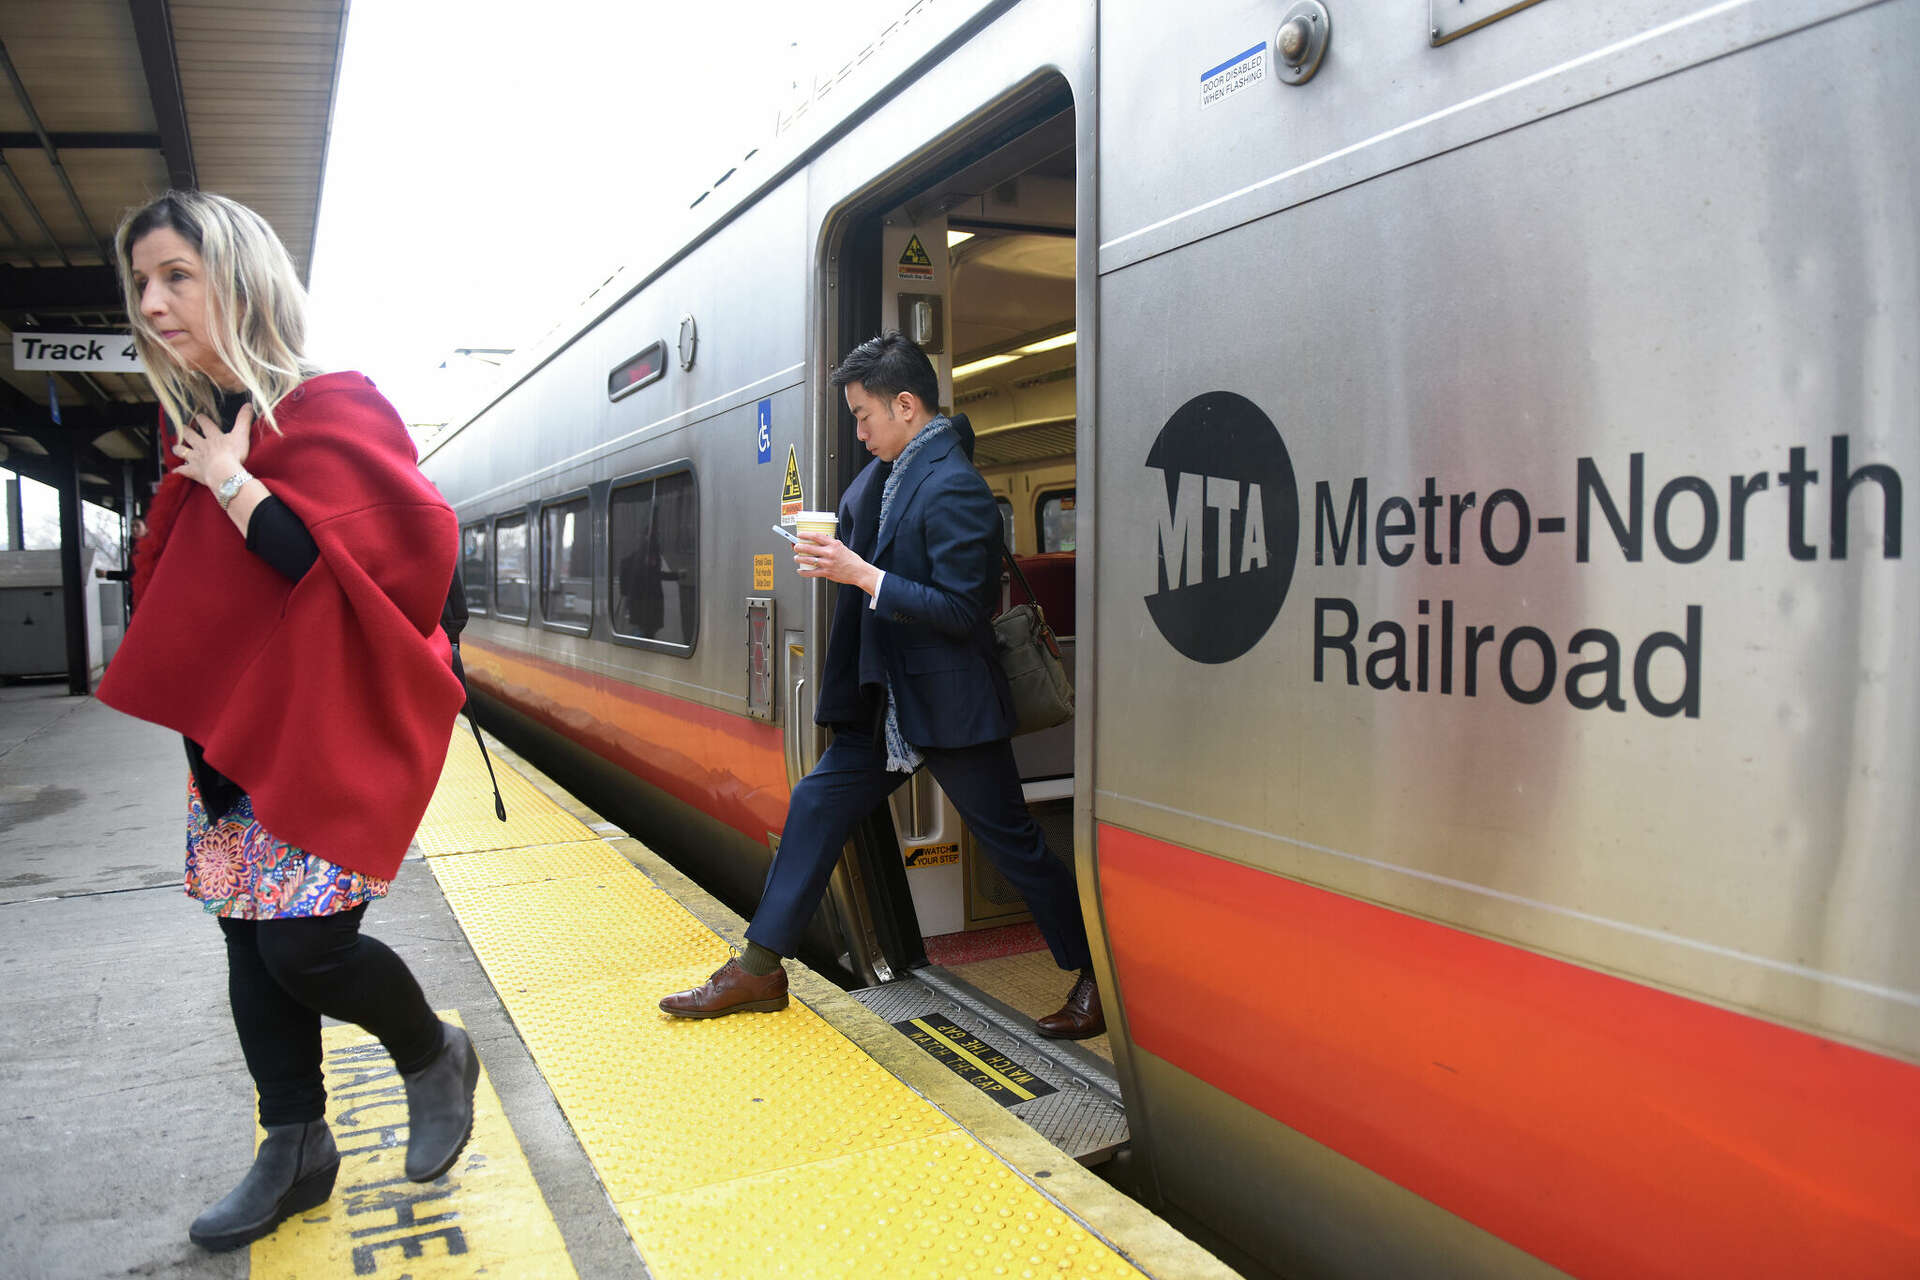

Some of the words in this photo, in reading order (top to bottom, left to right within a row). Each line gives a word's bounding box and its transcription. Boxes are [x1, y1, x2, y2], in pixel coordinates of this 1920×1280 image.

[1203, 75, 1224, 93] DOOR
[1225, 56, 1262, 82] DISABLED
[1203, 88, 1225, 105] WHEN
[1225, 68, 1262, 94] FLASHING
[21, 338, 104, 361] Track
[121, 342, 138, 361] 4
[1145, 468, 1268, 598] MTA
[1314, 434, 1904, 567] Metro-North
[1313, 597, 1703, 719] Railroad
[917, 856, 938, 865] YOUR
[940, 854, 959, 864] STEP
[923, 845, 952, 855] WATCH
[937, 1024, 966, 1040] GAP
[910, 1032, 949, 1057] WATCH
[947, 1057, 977, 1075] THE
[970, 1075, 1003, 1092] GAP
[961, 1039, 990, 1056] THE
[985, 1055, 1035, 1084] WATCH
